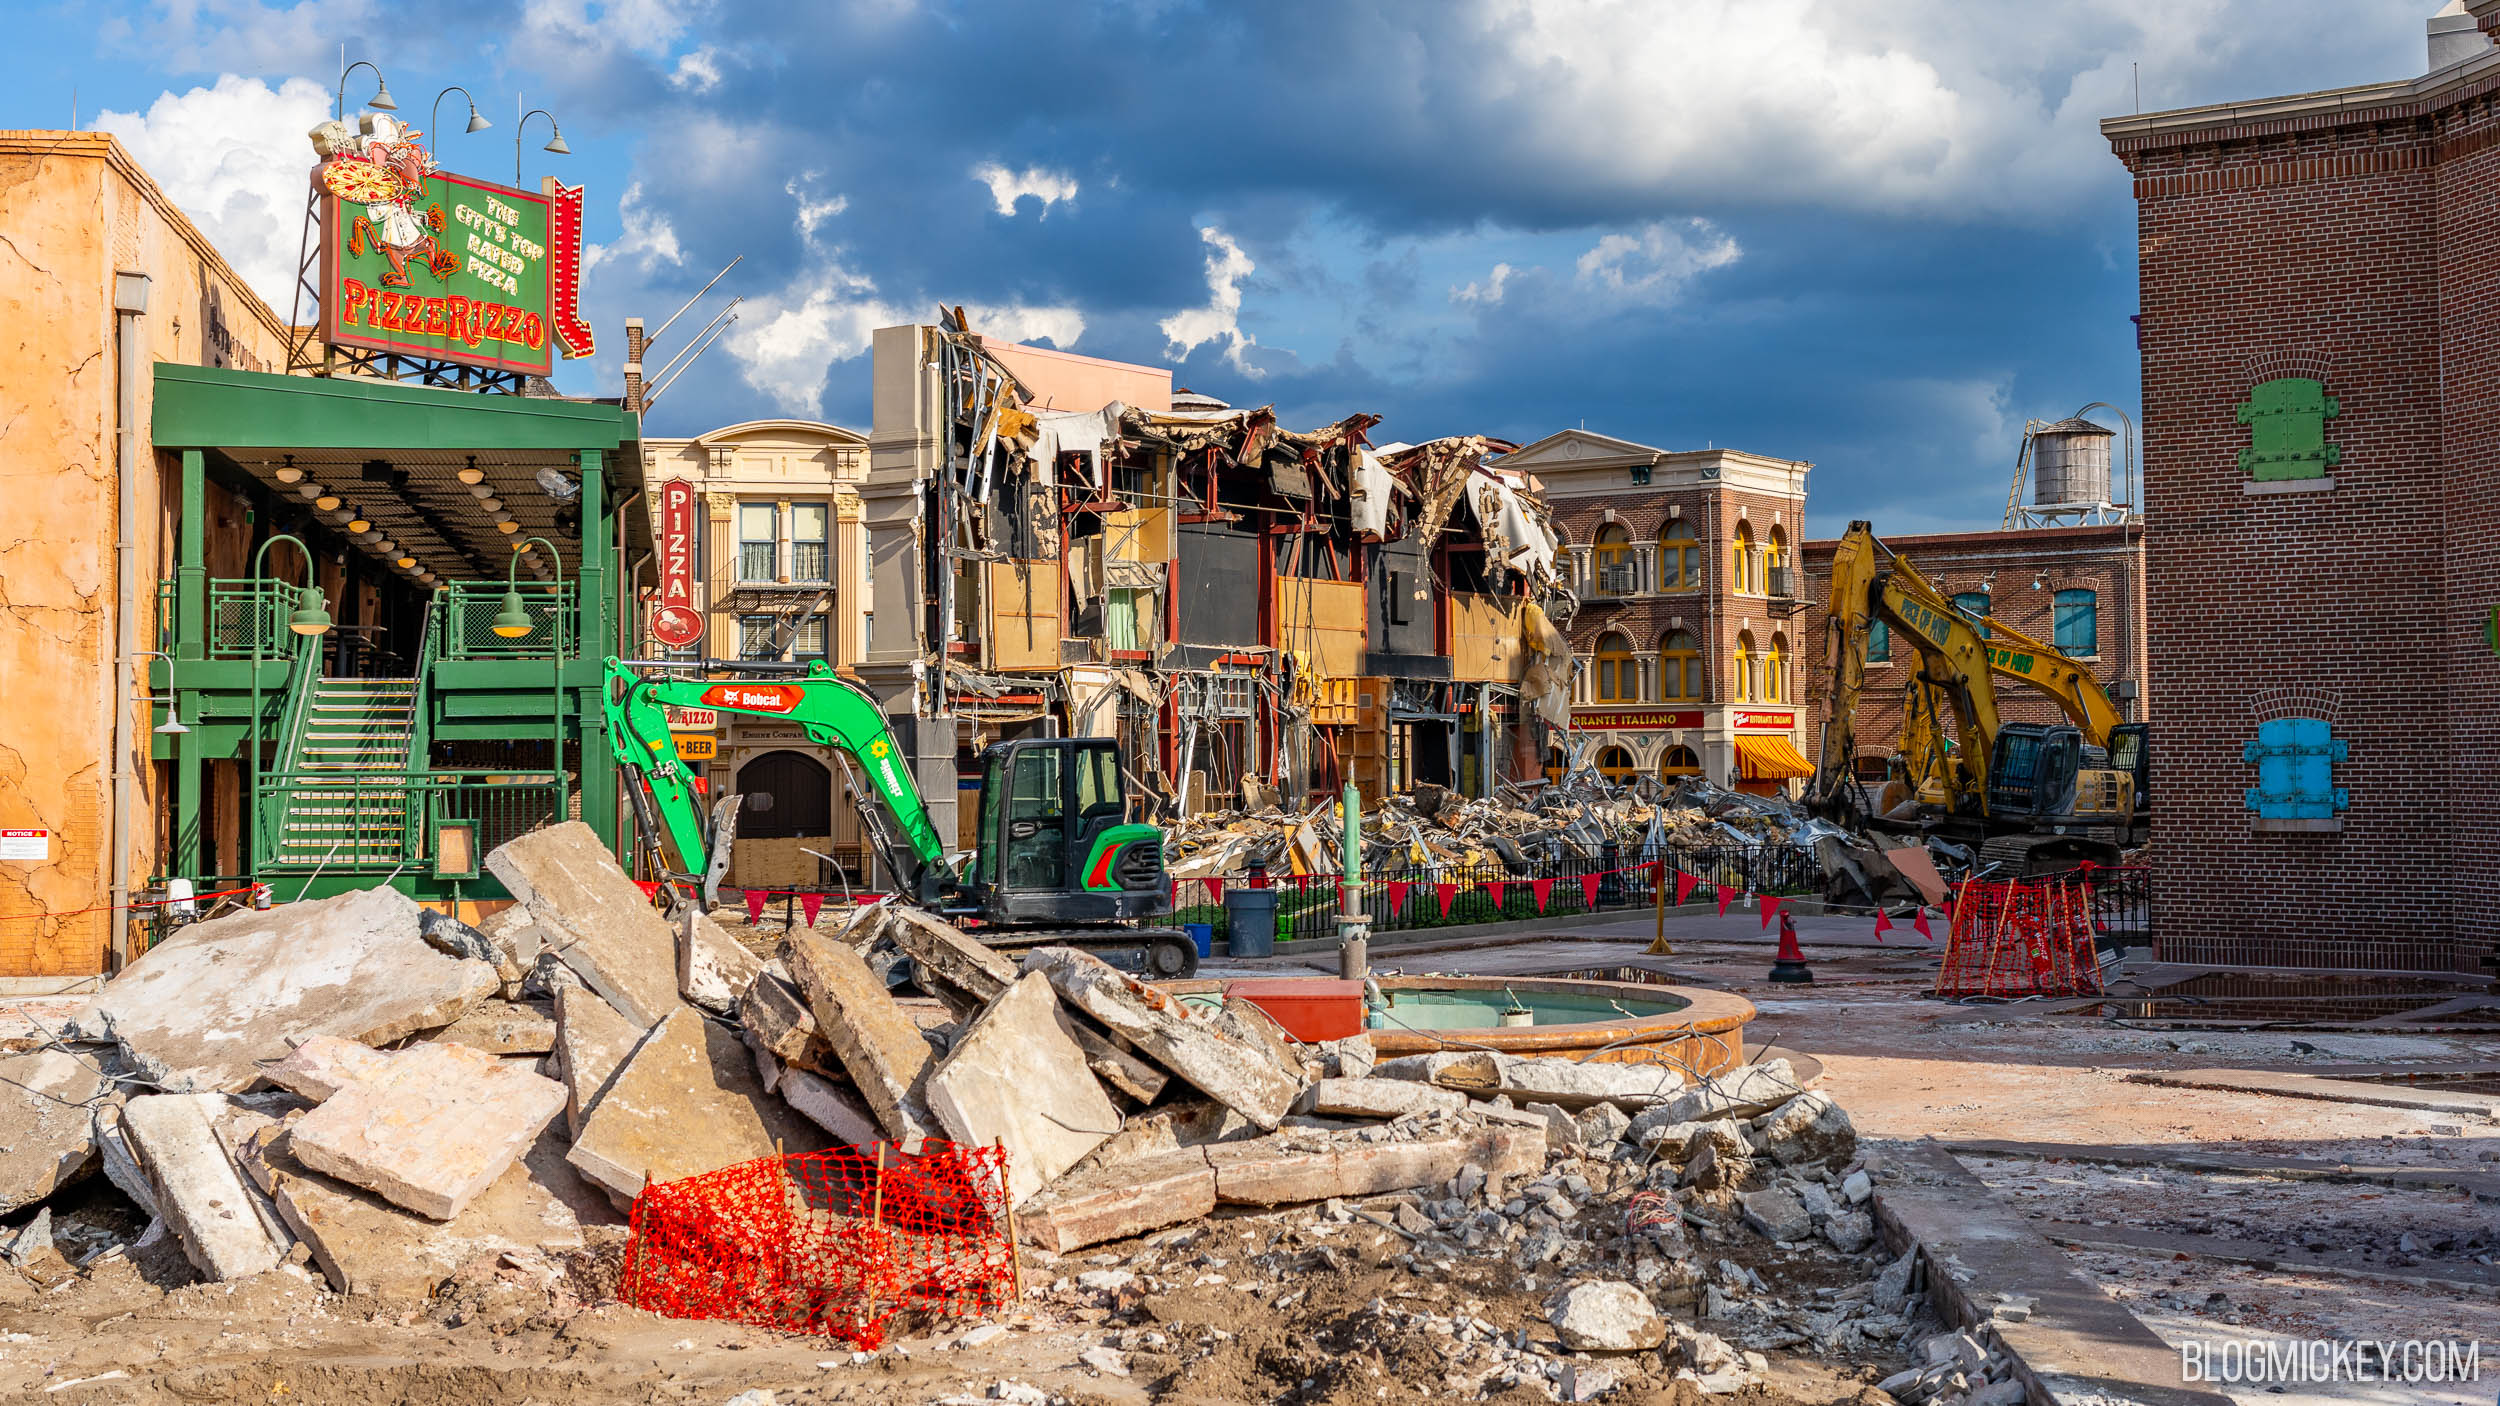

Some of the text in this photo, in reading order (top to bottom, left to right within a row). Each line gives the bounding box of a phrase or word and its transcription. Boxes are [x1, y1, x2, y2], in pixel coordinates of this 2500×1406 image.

[486, 195, 520, 228] THE
[467, 232, 525, 275] RATED
[510, 232, 545, 262] TOP
[467, 255, 518, 296] PIZZA
[343, 277, 545, 350] PIZZERIZZO
[668, 490, 687, 598] PIZZA
[743, 692, 781, 706] Bobcat
[1571, 714, 1677, 726] ORANTE ITALIANO
[686, 741, 712, 754] BEER
